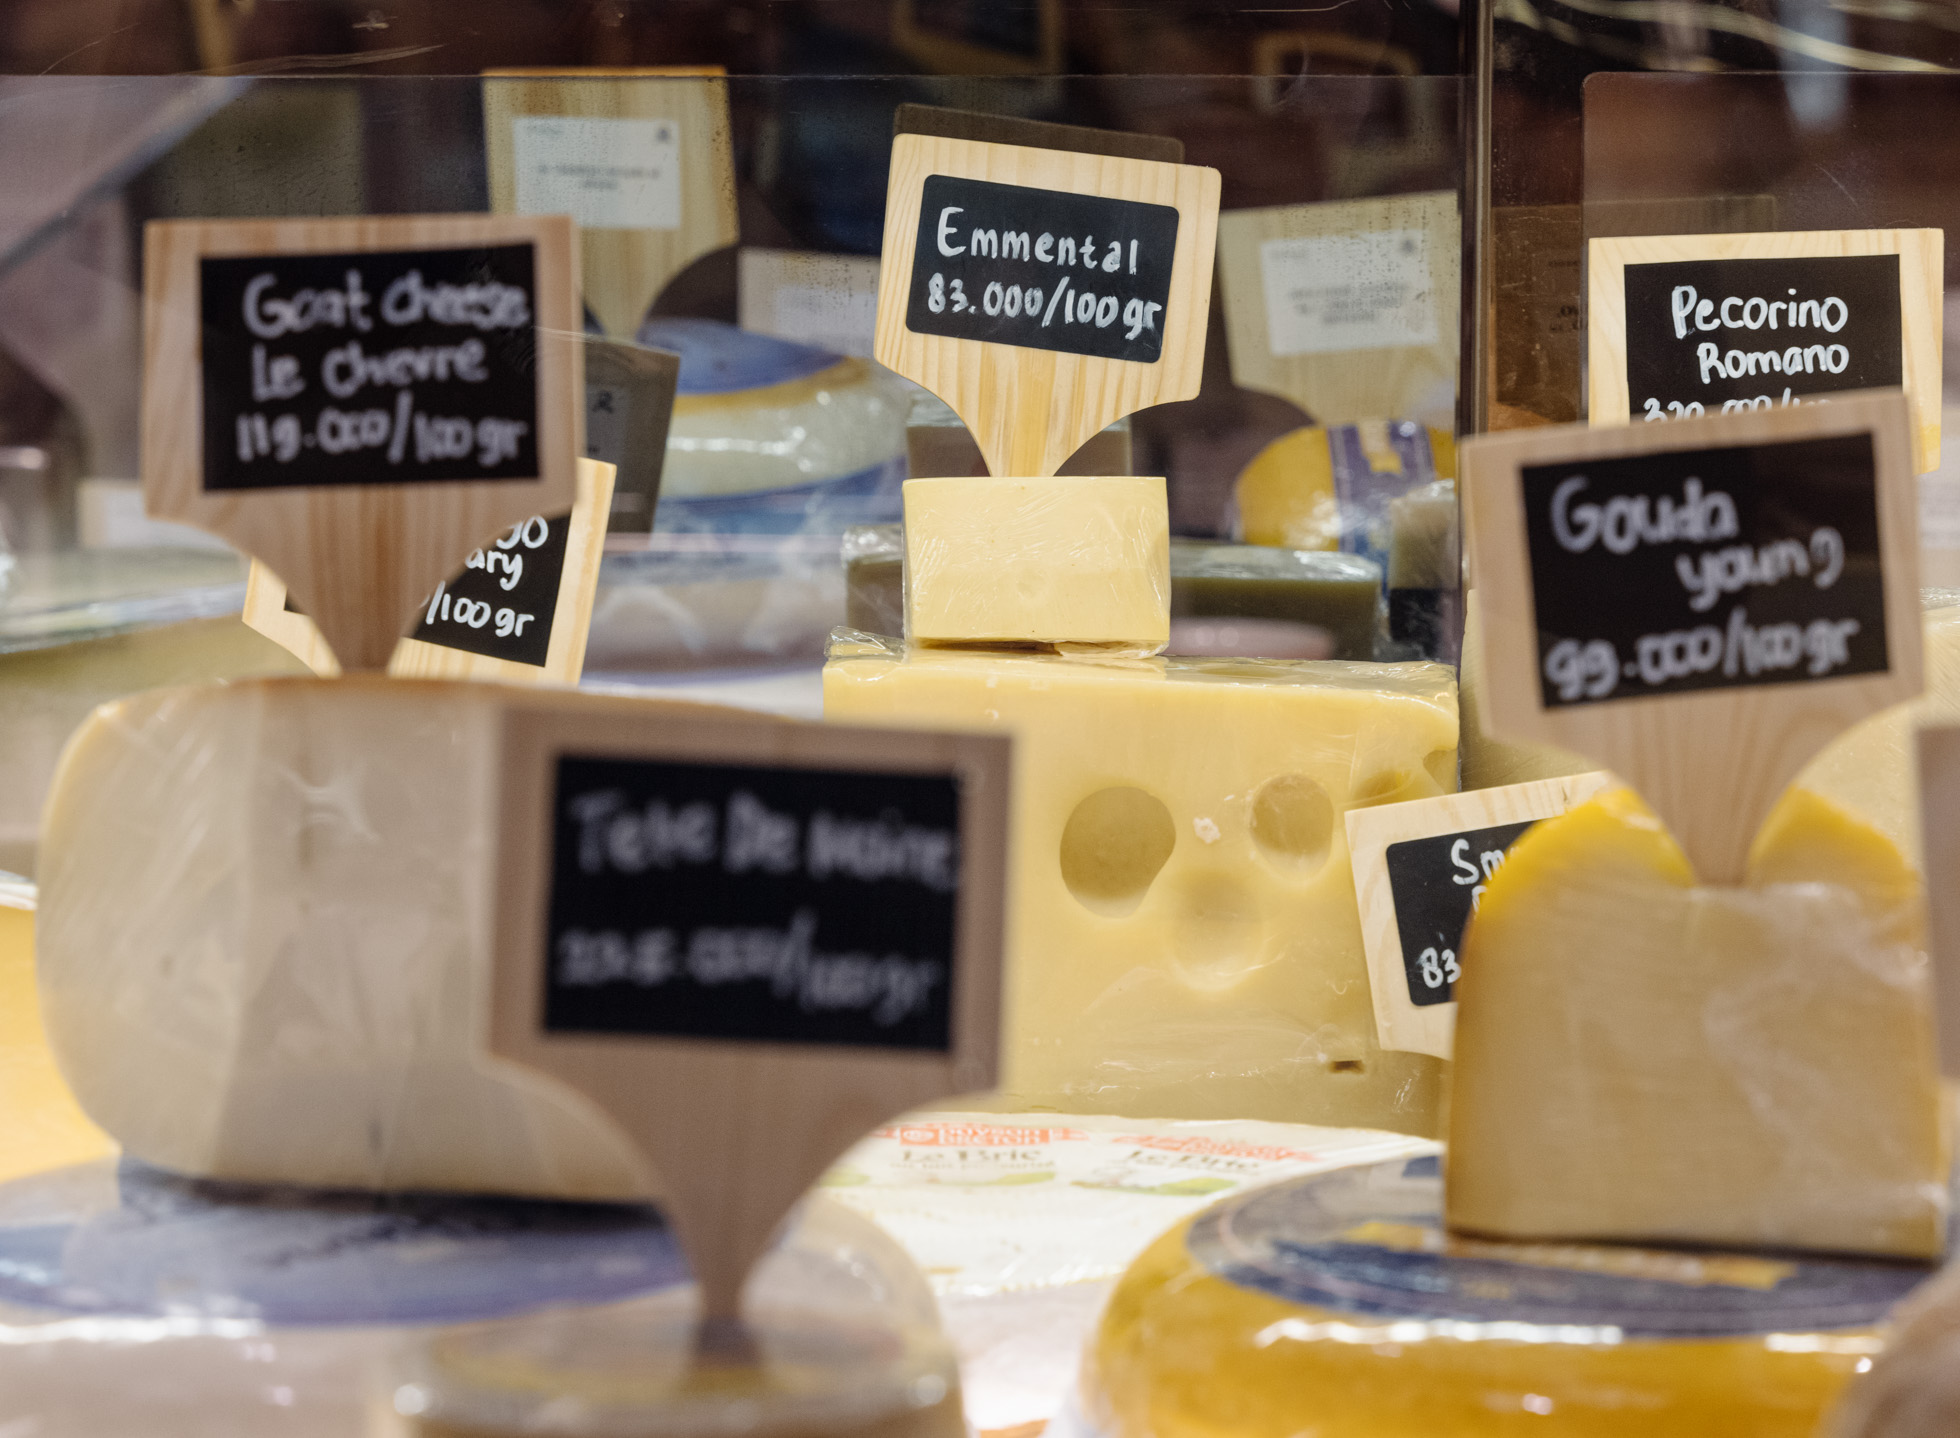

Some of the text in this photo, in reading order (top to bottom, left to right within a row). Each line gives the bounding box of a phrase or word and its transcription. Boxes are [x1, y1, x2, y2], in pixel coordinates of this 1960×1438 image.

[936, 206, 1140, 275] Emmental
[242, 268, 372, 338] Goat
[1671, 285, 1849, 339] Pecorino
[1697, 341, 1850, 384] Romano
[1550, 474, 1740, 554] Gouda
[1675, 526, 1845, 612] young
